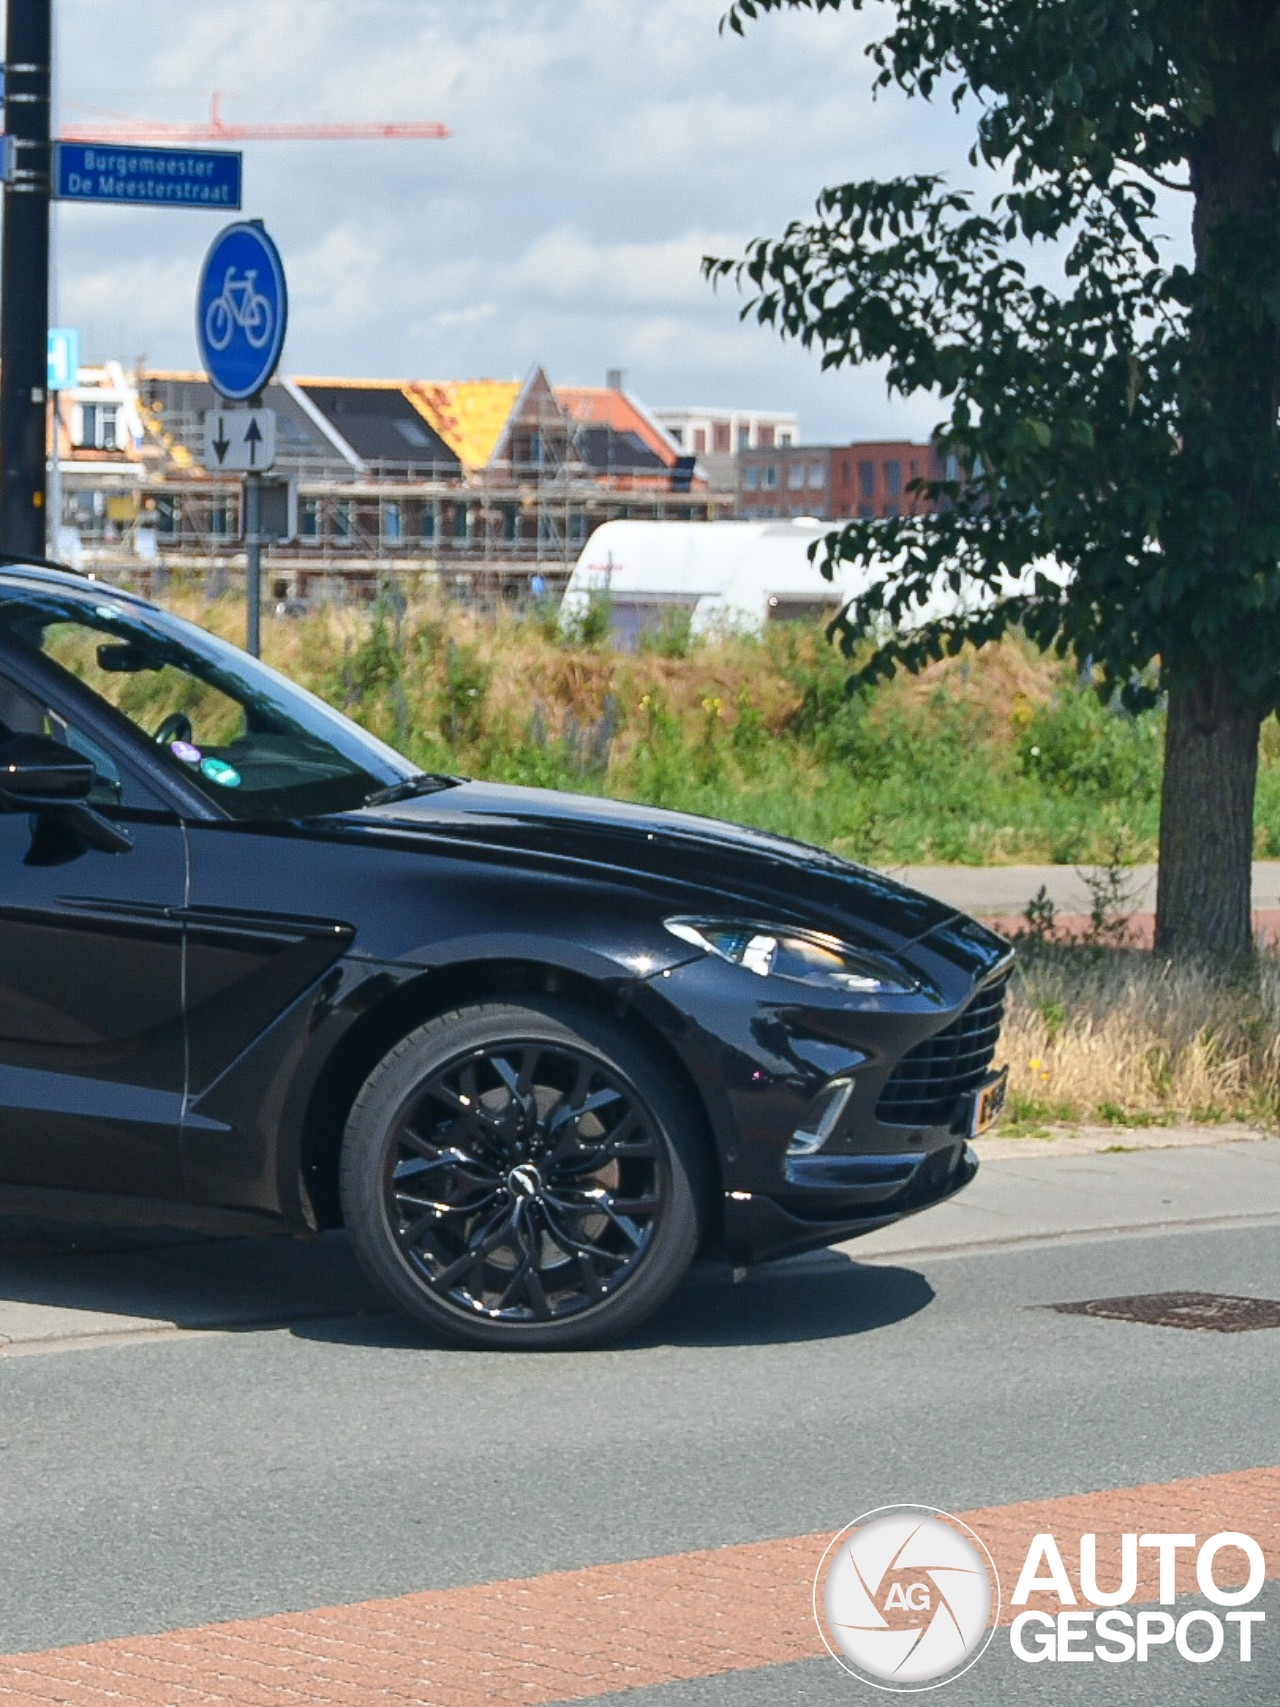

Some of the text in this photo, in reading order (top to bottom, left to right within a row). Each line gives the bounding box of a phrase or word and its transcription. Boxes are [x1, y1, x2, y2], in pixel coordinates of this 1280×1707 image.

[84, 150, 214, 177] Burgemeester
[68, 173, 229, 201] De Meesterstraat
